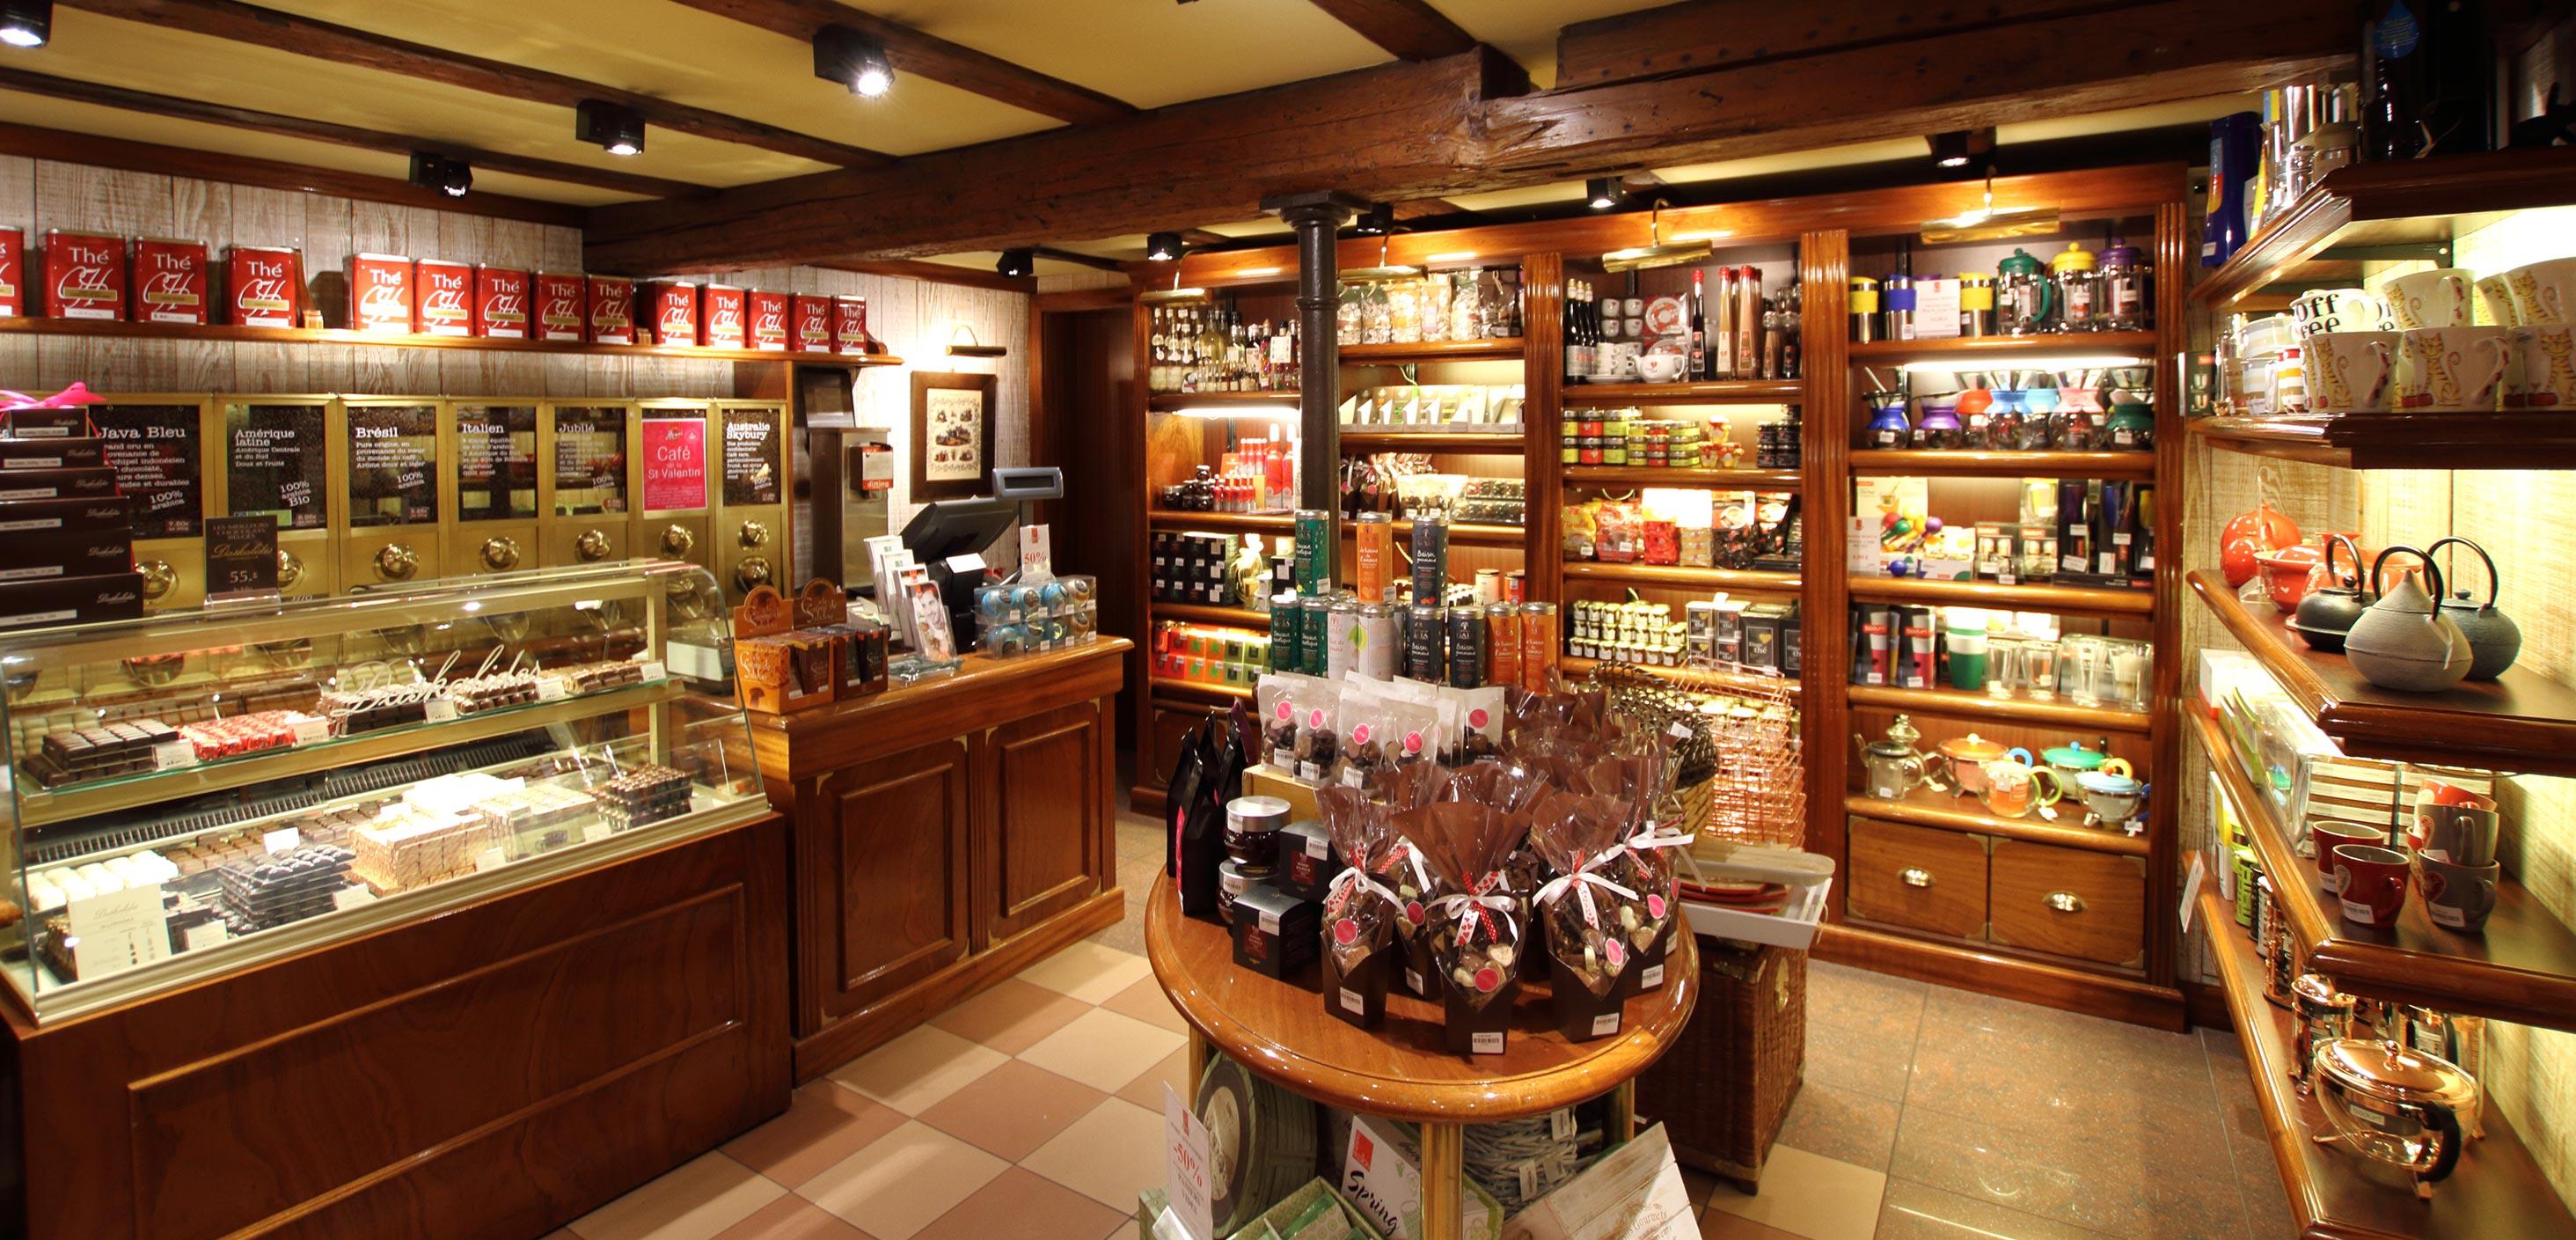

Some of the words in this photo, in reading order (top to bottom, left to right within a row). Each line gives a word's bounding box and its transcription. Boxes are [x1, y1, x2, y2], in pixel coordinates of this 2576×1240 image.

[69, 247, 109, 264] Thé
[153, 253, 191, 270] Thé
[247, 260, 282, 278] Thé
[370, 269, 402, 284] Thé
[432, 274, 462, 290] Thé
[492, 278, 520, 293] Thé
[549, 283, 575, 297] Thé
[597, 284, 623, 297] Thé
[667, 293, 689, 306] Thé
[716, 297, 738, 310] Thé
[761, 300, 781, 313] Thé
[805, 304, 824, 316] Thé
[99, 426, 141, 439] Java
[146, 426, 187, 438] Bleu
[355, 427, 399, 438] Brésil
[462, 423, 504, 434] Italien
[559, 423, 595, 433] Jubilé
[727, 422, 771, 431] Australie
[235, 429, 295, 439] Amérique
[727, 430, 767, 441] Skybury
[657, 444, 691, 462] Café
[397, 472, 423, 483] 100%
[648, 469, 658, 480] St
[662, 467, 701, 479] Valentin
[281, 481, 310, 493] 100%
[150, 490, 183, 503] 100%
[288, 495, 310, 507] Bio
[1024, 551, 1047, 564] 50%
[1348, 1170, 1397, 1236] Spring
